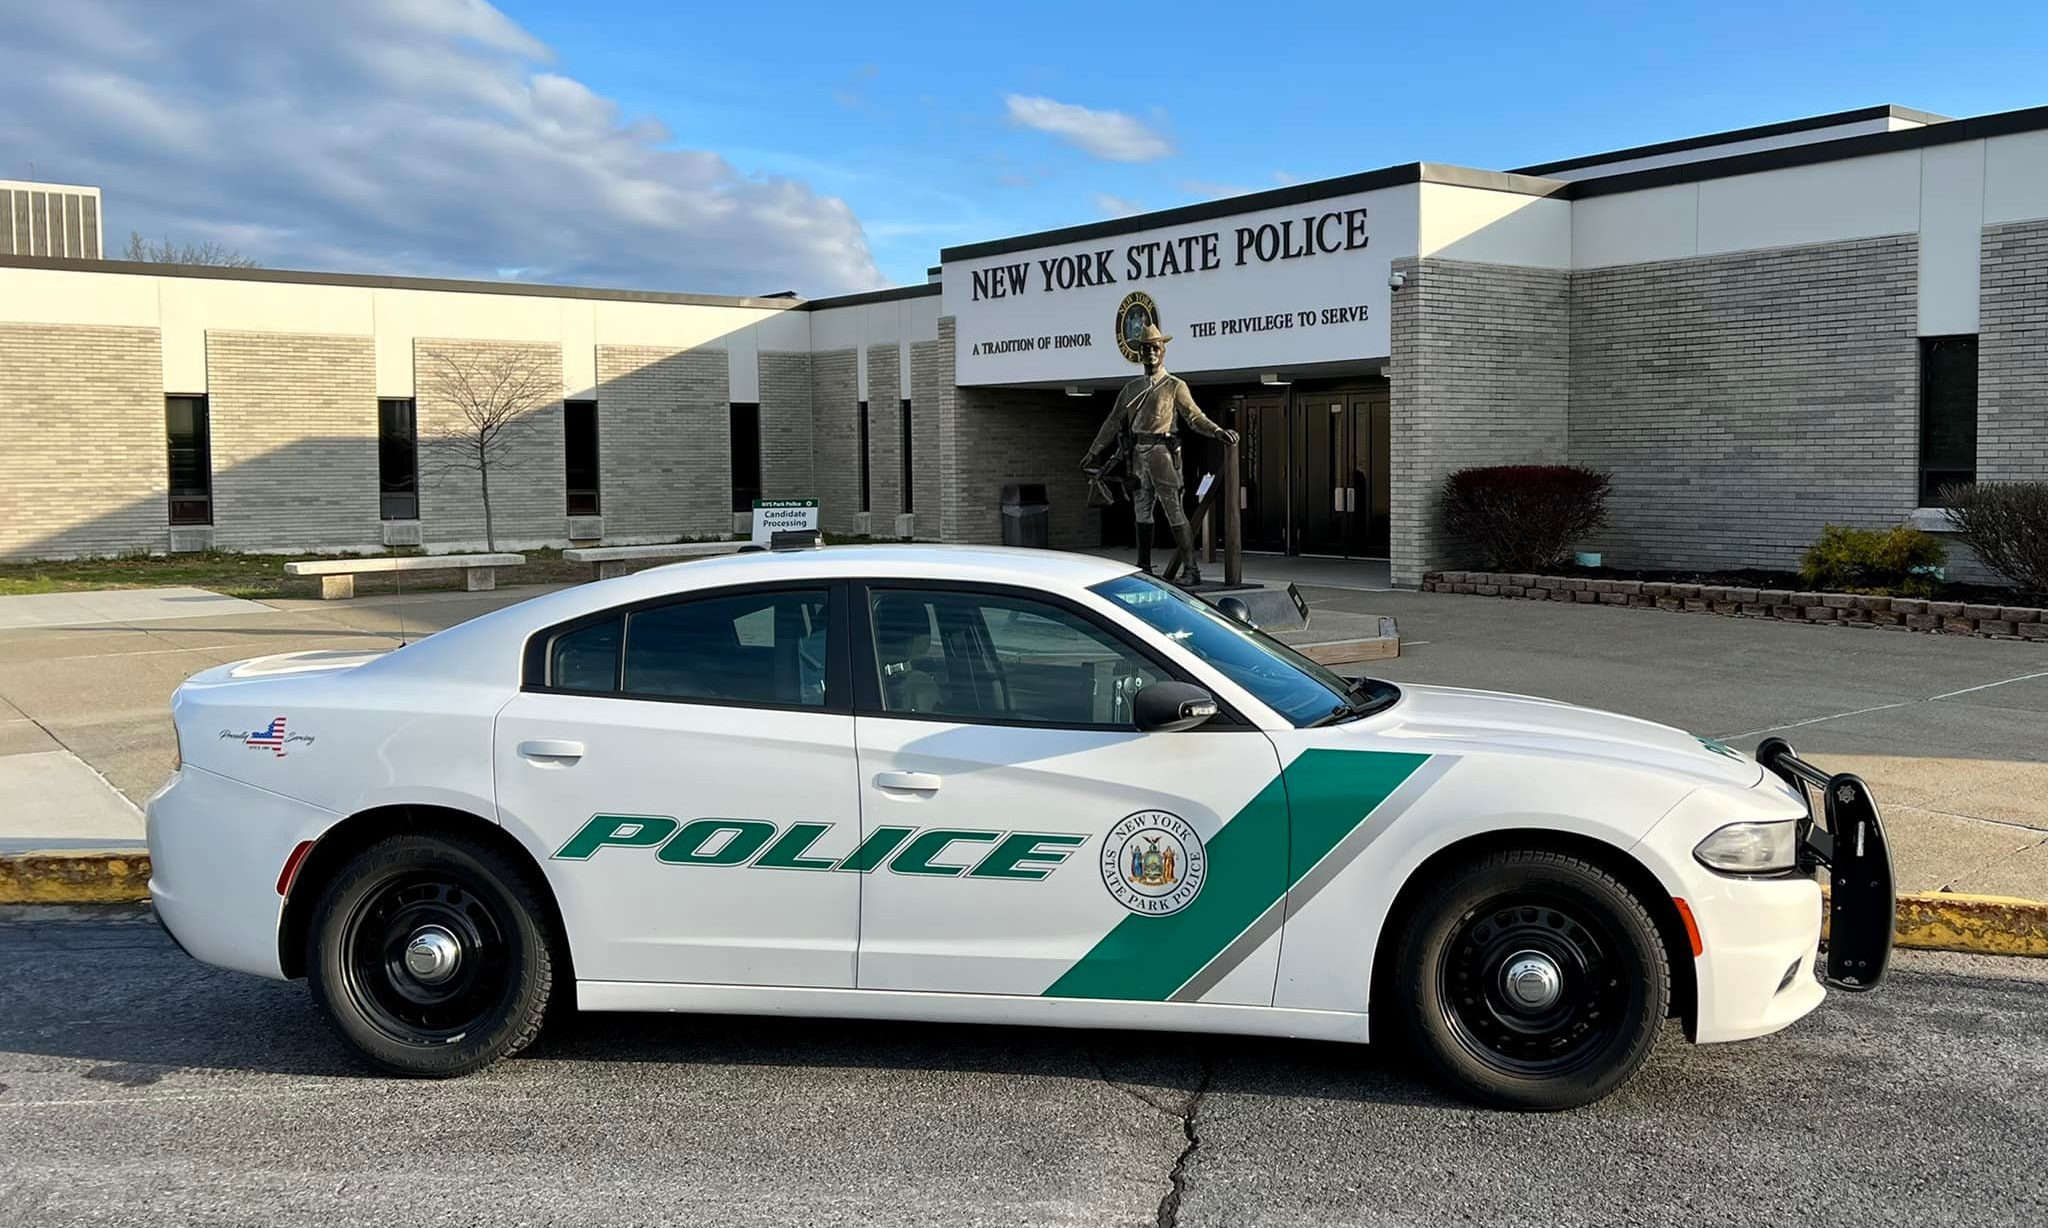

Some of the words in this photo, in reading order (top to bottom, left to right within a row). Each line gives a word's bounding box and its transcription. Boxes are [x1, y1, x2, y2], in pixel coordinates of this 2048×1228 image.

[971, 262, 1030, 302] NEW
[1038, 249, 1117, 292] YORK
[1126, 232, 1221, 281] STATE
[1234, 208, 1369, 266] POLICE
[1190, 321, 1217, 338] THE
[1221, 313, 1294, 335] PRIVILEGE
[1298, 310, 1317, 327] TO
[1321, 305, 1369, 325] SERVE
[972, 343, 980, 356] A
[981, 337, 1034, 355] TRADITION
[1037, 336, 1051, 349] OF
[1054, 333, 1092, 349] HONOR
[763, 519, 807, 528] Processing
[764, 510, 807, 518] Candidate
[1115, 815, 1146, 841] NEW
[1151, 814, 1191, 842] YORK
[549, 812, 1093, 882] POLICE
[1105, 848, 1127, 898] STATE
[1128, 894, 1170, 912] PARK
[1172, 851, 1202, 905] POLICE
